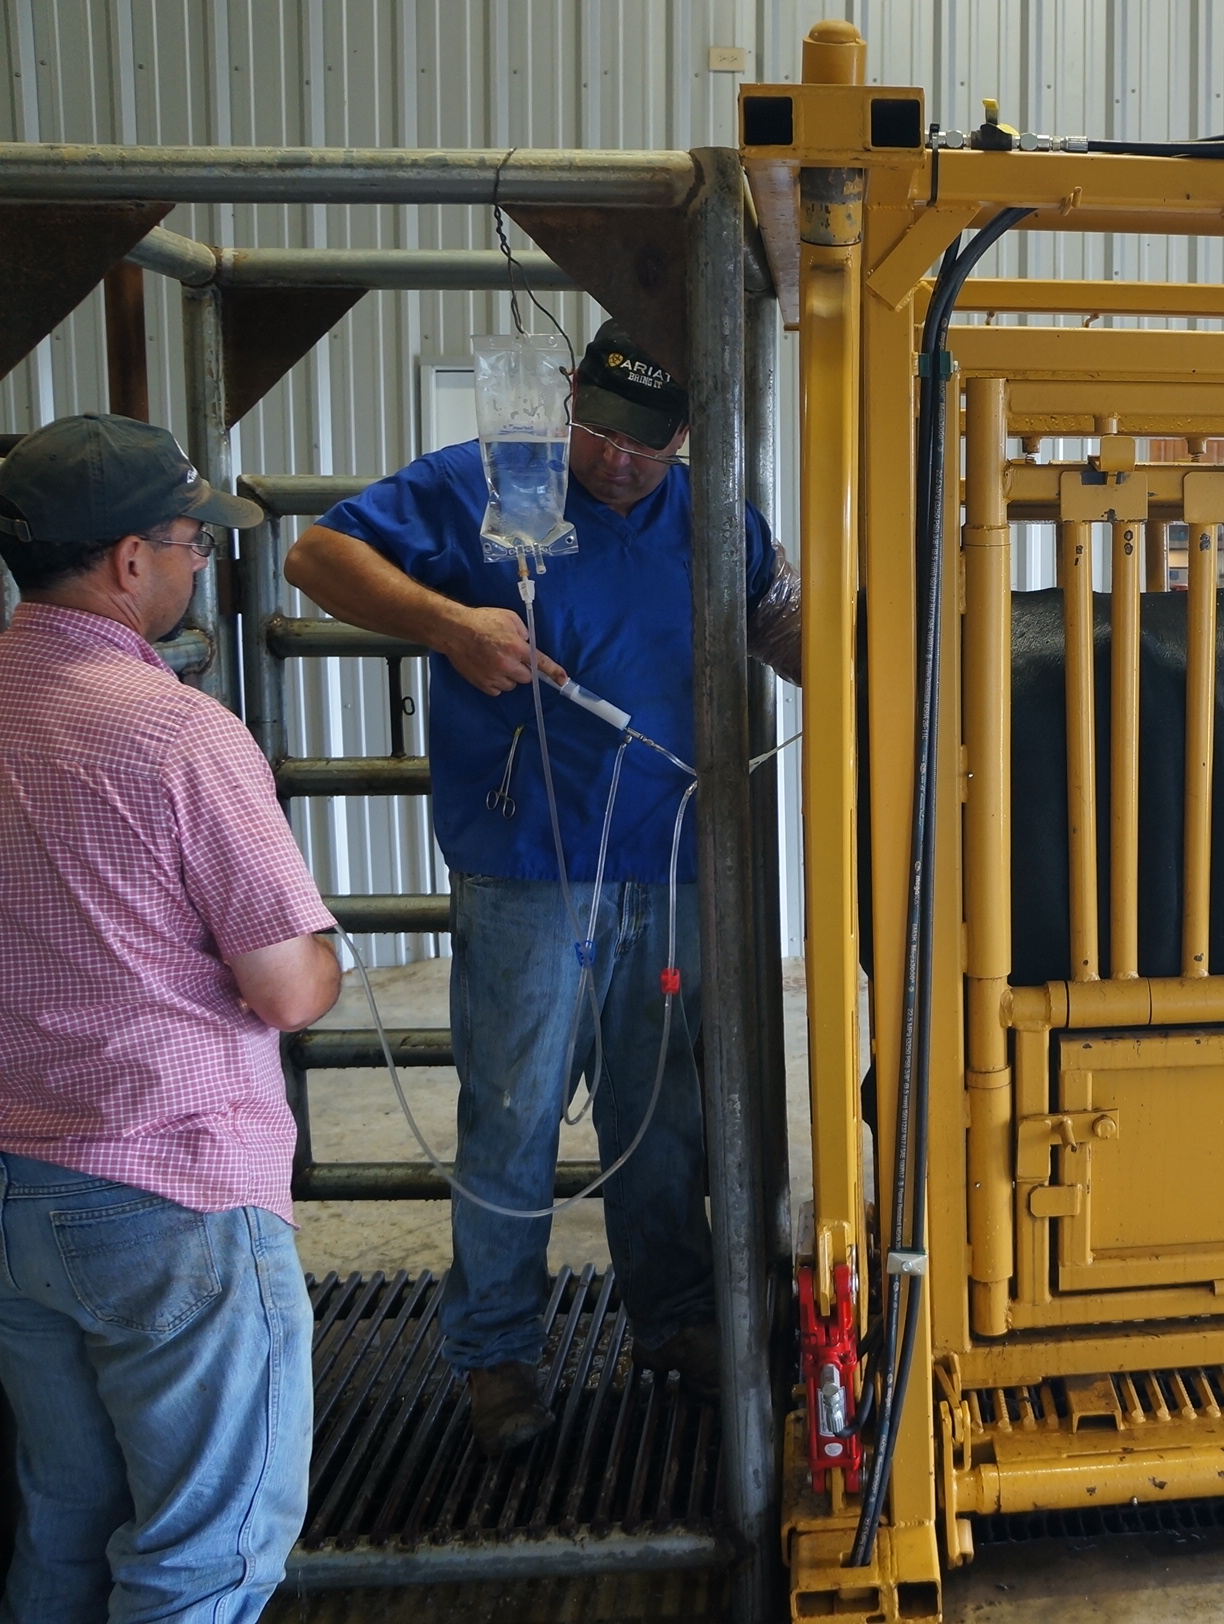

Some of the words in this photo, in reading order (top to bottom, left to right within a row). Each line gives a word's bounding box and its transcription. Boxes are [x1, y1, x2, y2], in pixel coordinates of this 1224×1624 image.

[627, 371, 653, 388] BRING
[653, 380, 663, 389] IT
[901, 1095, 909, 1109] mm)
